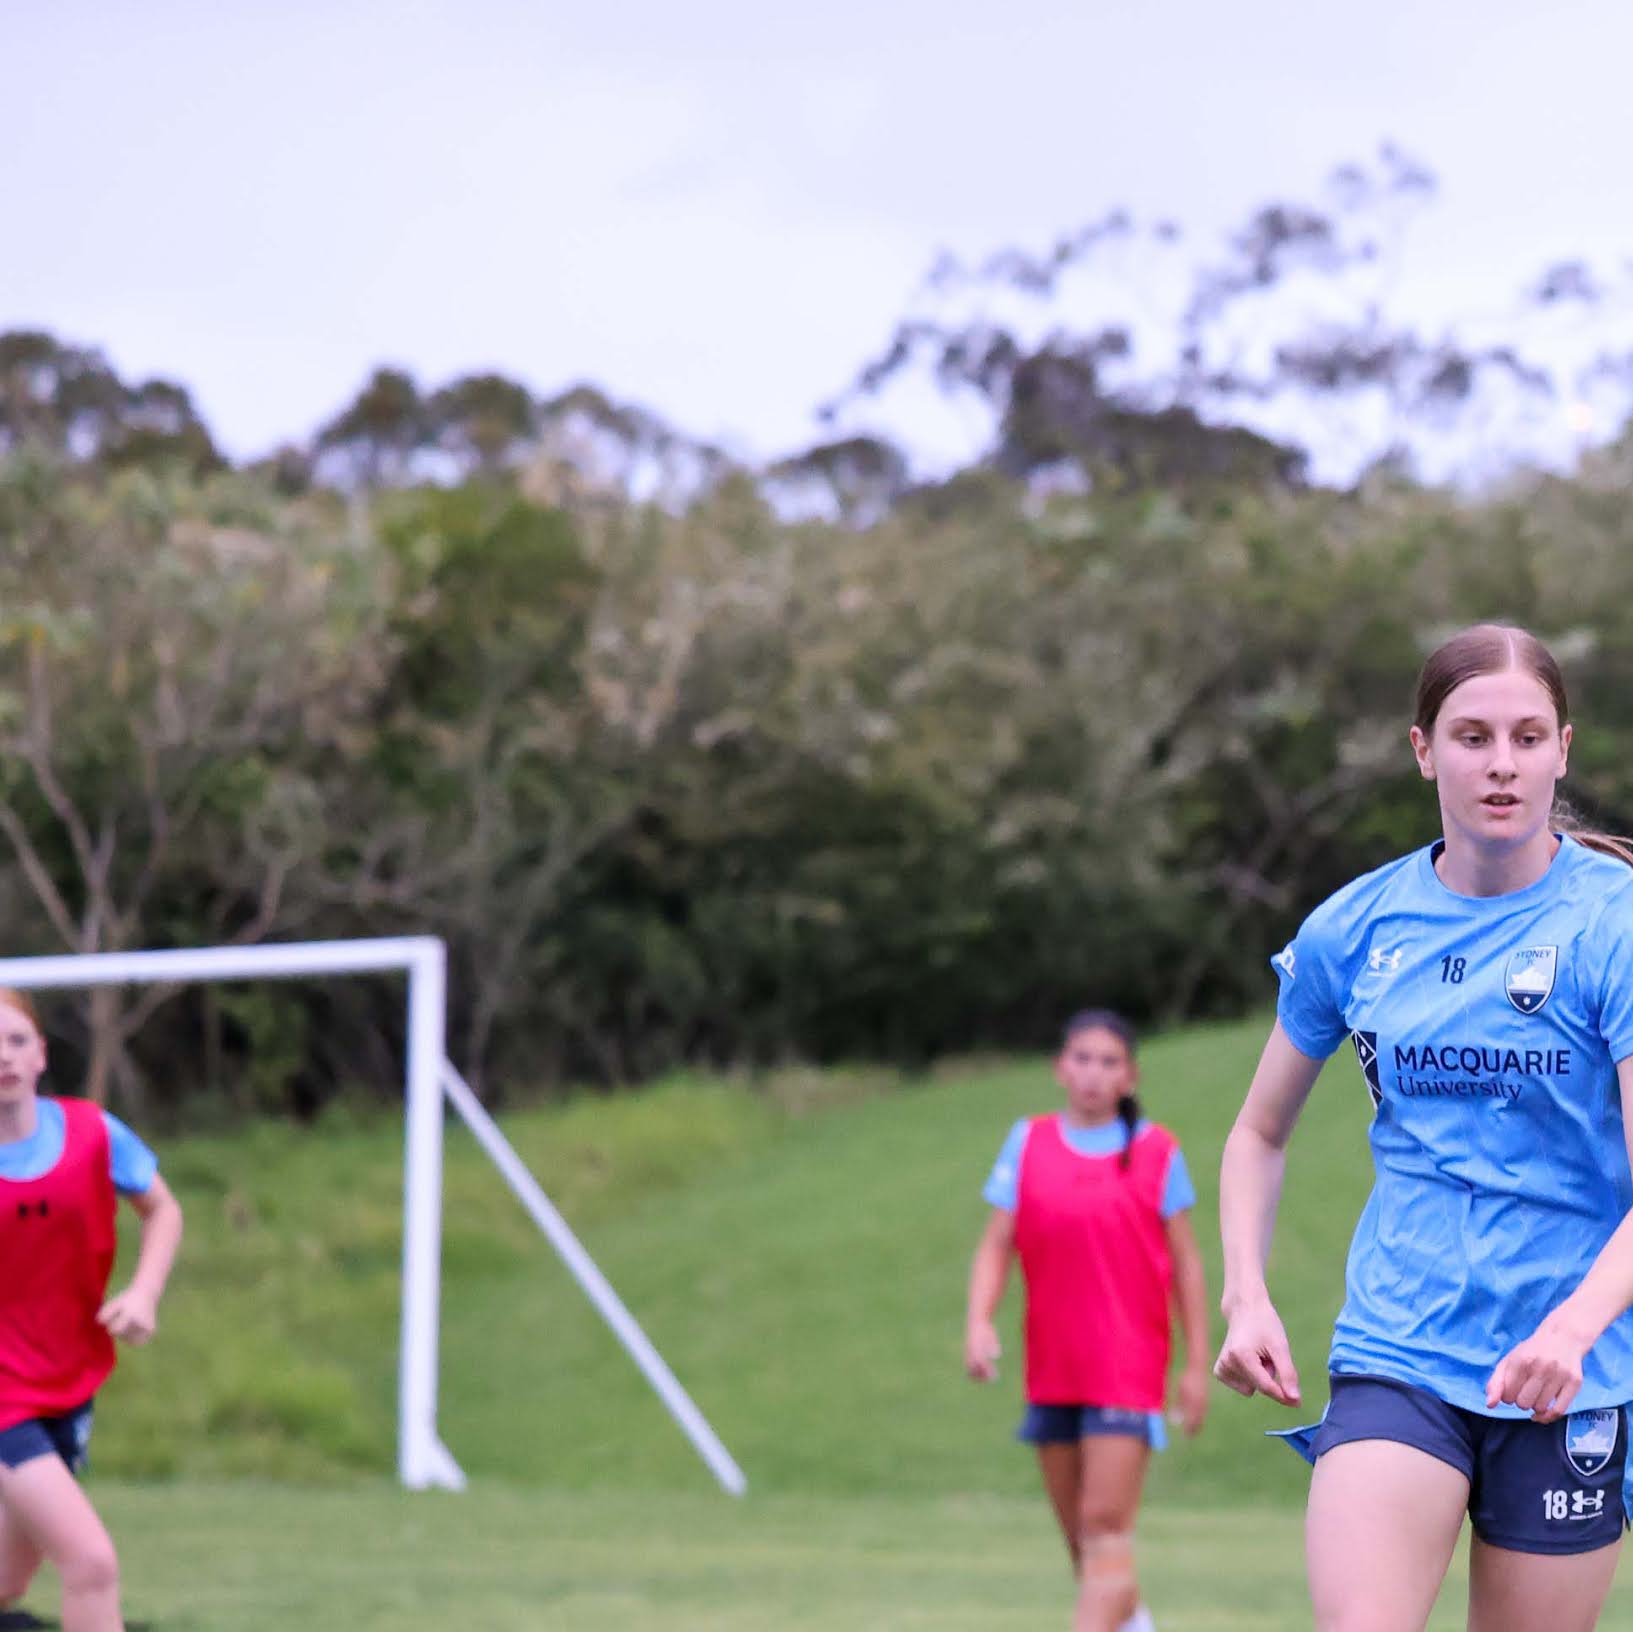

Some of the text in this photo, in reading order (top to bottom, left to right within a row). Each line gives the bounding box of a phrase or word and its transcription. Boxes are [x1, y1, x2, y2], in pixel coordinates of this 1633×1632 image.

[1441, 954, 1467, 984] 18
[1394, 1045, 1571, 1077] MACQUARIE
[1397, 1075, 1523, 1100] University
[1542, 1489, 1569, 1520] 18
